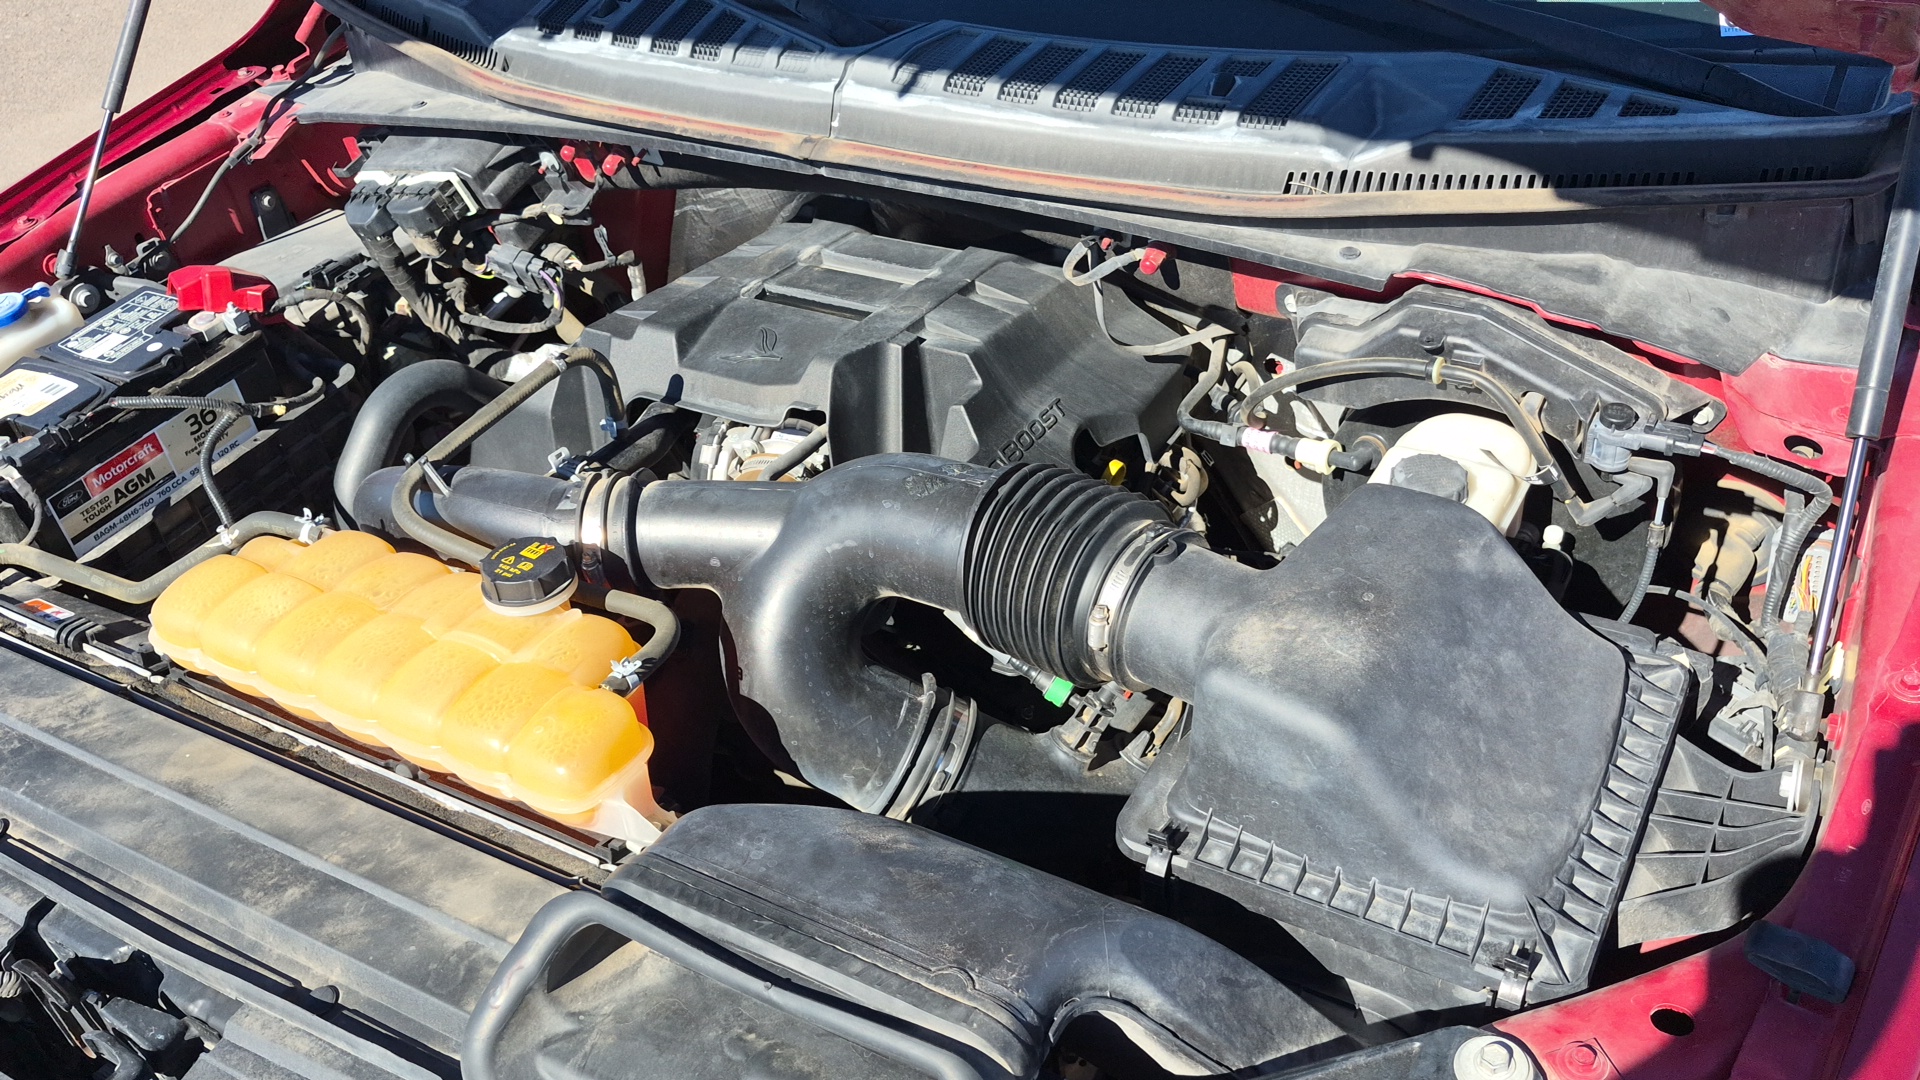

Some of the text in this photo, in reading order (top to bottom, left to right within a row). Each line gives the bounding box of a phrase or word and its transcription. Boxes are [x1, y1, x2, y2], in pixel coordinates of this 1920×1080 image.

[184, 408, 217, 436] 36
[988, 397, 1066, 467] BOOST
[91, 442, 155, 488] Motorcraft
[217, 440, 240, 458] 120 RC
[62, 493, 80, 508] Ford
[113, 467, 156, 505] AGM
[79, 495, 110, 518] TESTED
[93, 467, 200, 542] BAGM-48H6-760 760 CCA 95
